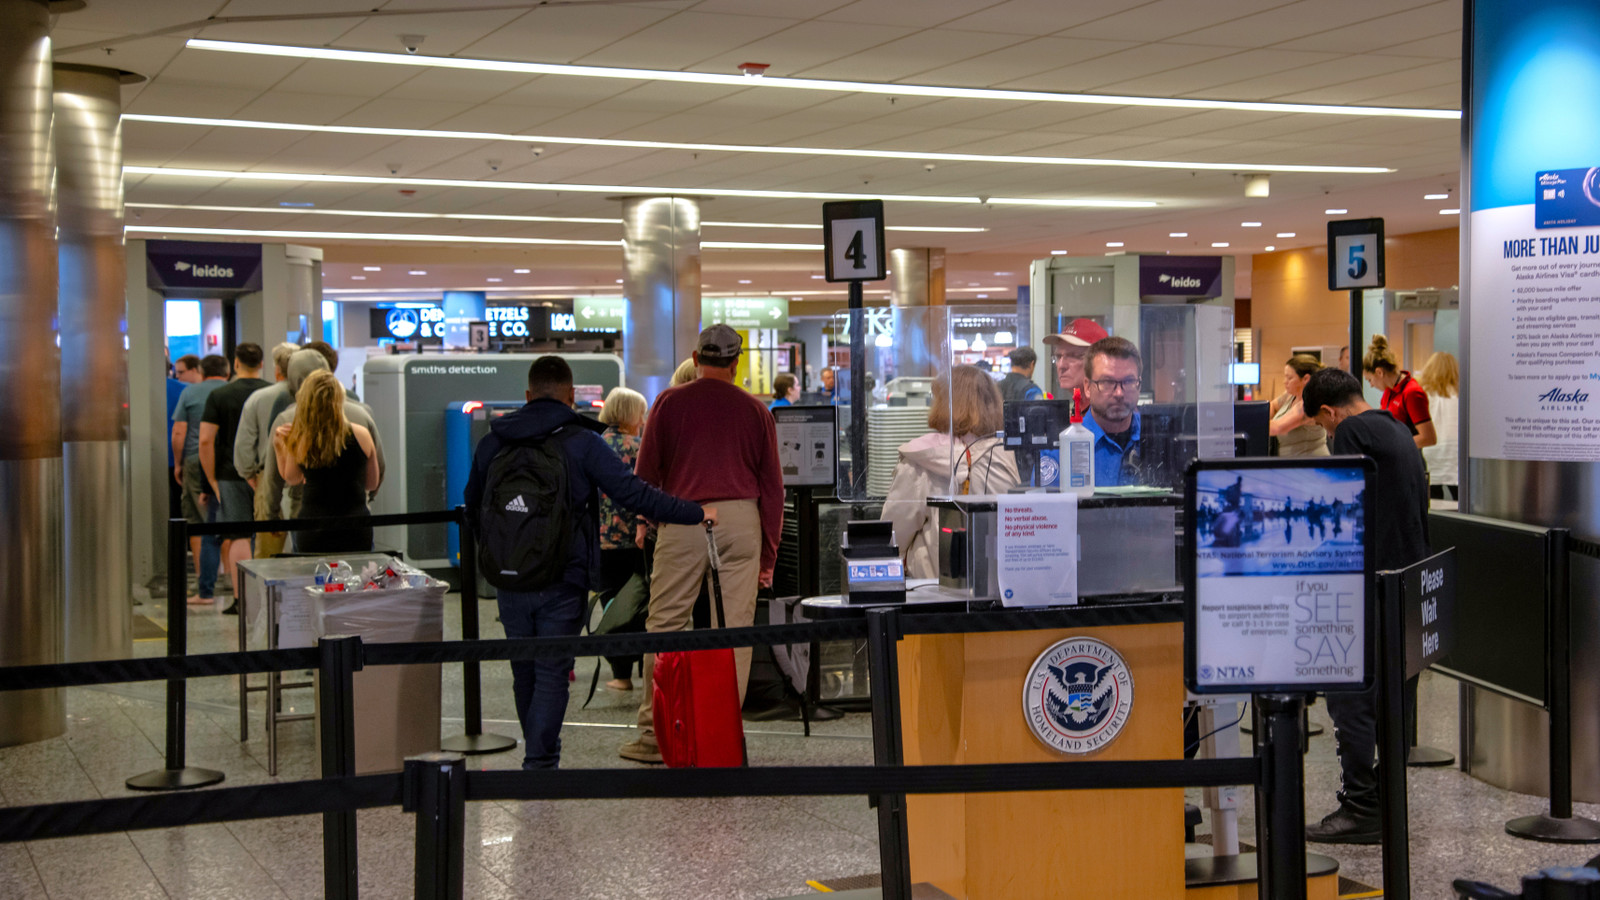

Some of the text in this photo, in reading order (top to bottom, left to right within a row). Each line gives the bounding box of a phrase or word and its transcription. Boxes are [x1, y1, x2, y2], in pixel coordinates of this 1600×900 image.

[844, 230, 867, 270] 4
[1504, 234, 1600, 258] MORE THAN JU
[1348, 244, 1368, 280] 5
[192, 264, 234, 278] leidos
[1171, 276, 1201, 288] leidos
[476, 330, 484, 342] 3
[501, 322, 530, 336] CO.
[411, 365, 497, 374] smiths detection
[1538, 387, 1589, 404] Alaska
[1297, 550, 1332, 559] Advisory
[1335, 550, 1364, 558] System
[1296, 580, 1328, 592] if you
[1421, 568, 1444, 596] Please
[1263, 604, 1289, 612] activity
[1295, 592, 1354, 623] SEE
[1421, 596, 1438, 627] Wait
[1228, 612, 1250, 620] airport
[1296, 624, 1354, 635] something
[1295, 635, 1356, 665] SAY
[1422, 631, 1439, 658] Here
[1050, 644, 1122, 670] DEPARTMENT
[1118, 671, 1128, 687] OF
[1217, 666, 1255, 678] NTAS
[1032, 700, 1128, 750] HOMELAND SECURITY
